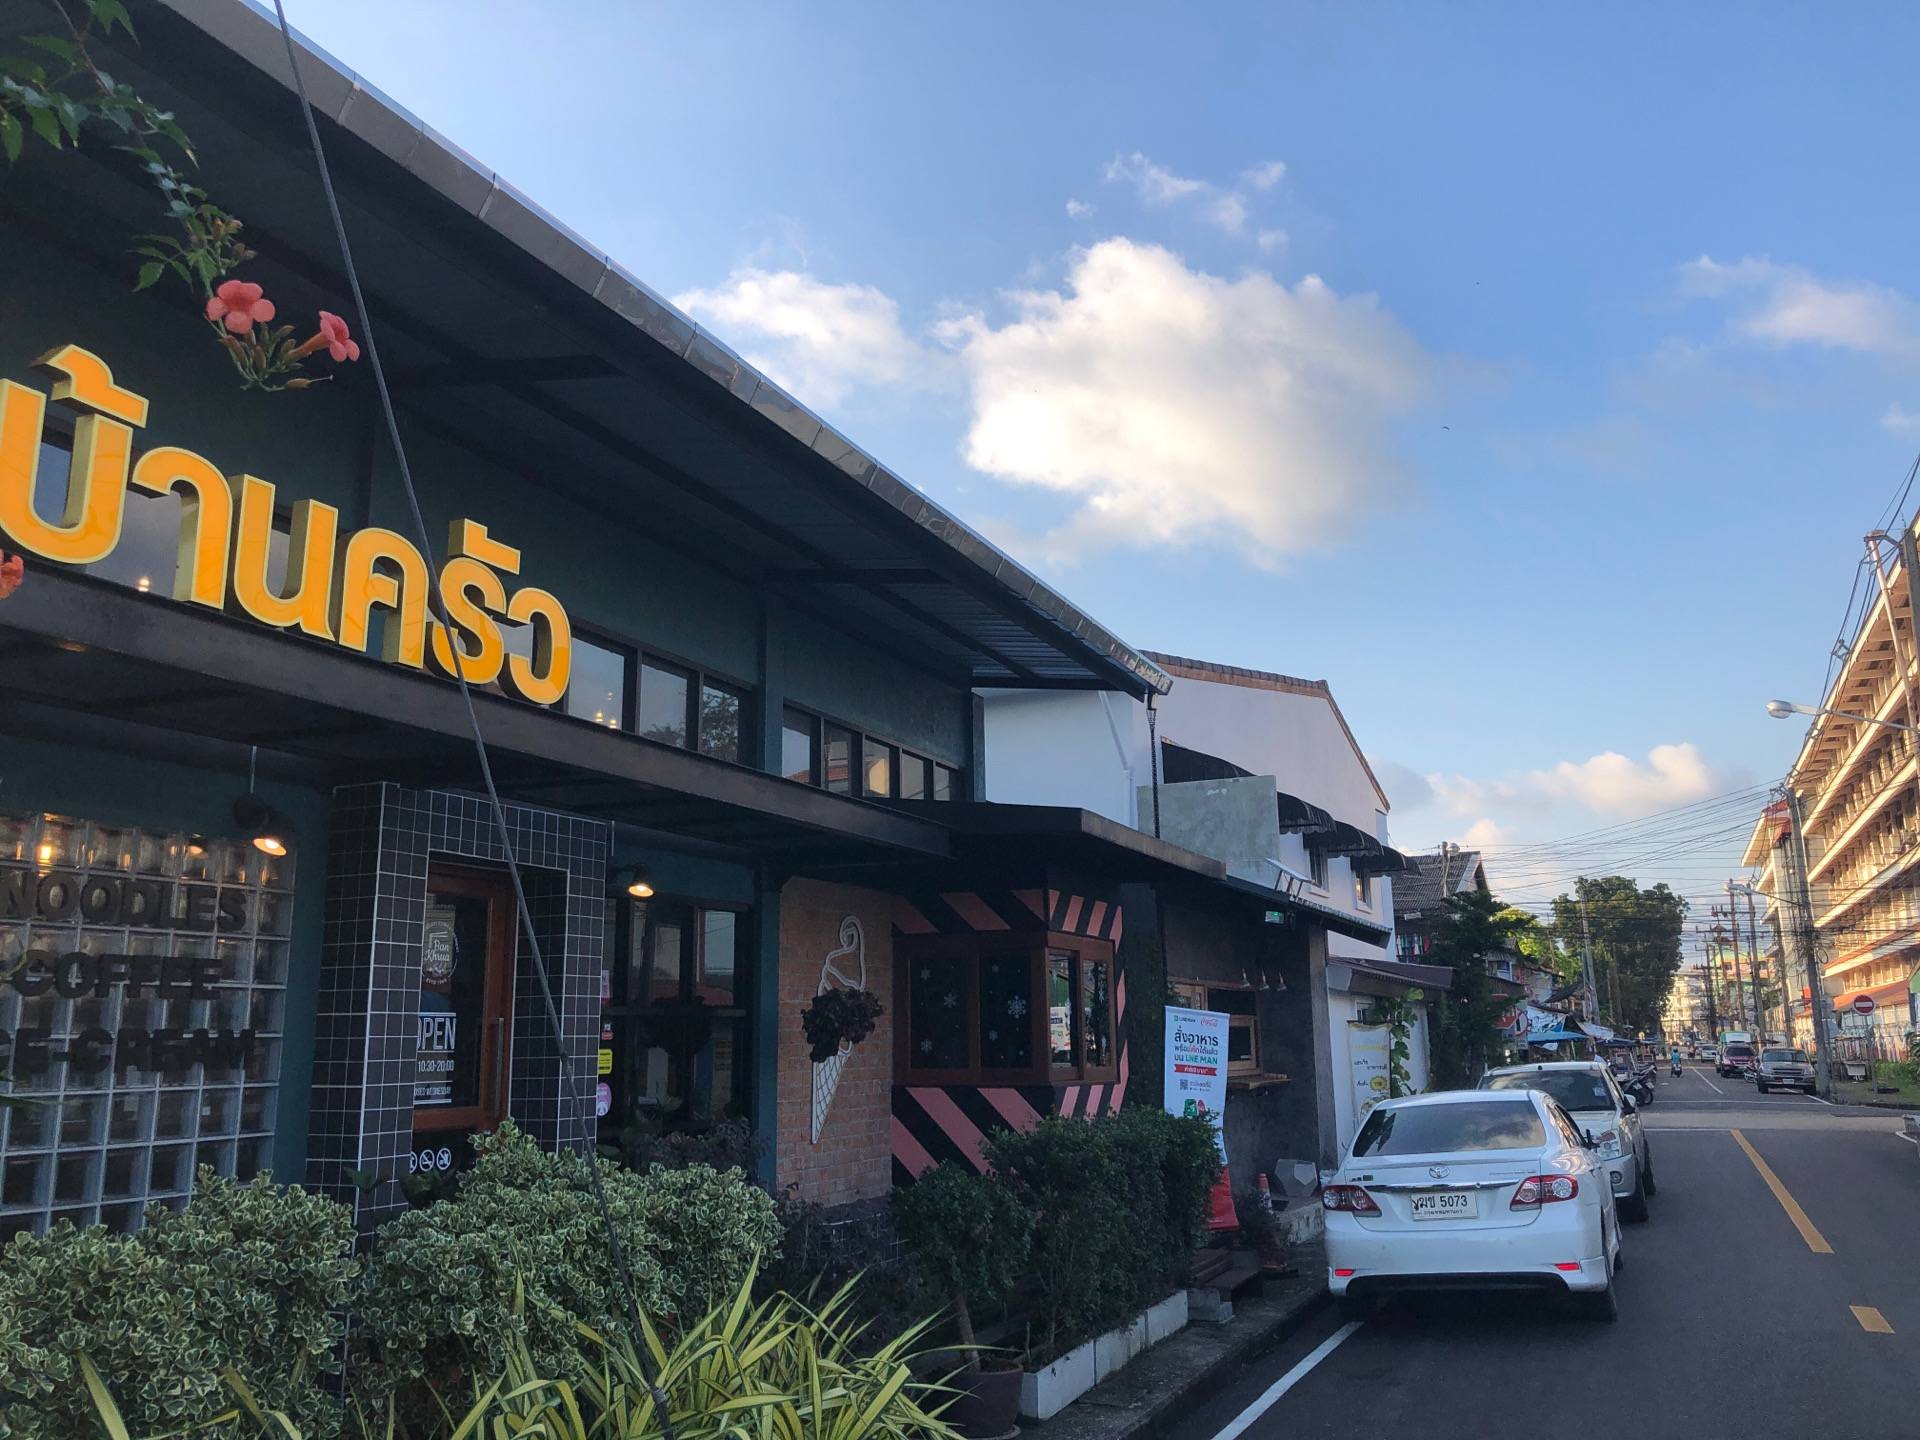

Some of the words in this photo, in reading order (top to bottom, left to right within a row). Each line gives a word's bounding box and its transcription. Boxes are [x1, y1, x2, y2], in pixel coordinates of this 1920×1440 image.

[0, 344, 571, 705] บ้านครัว
[0, 869, 248, 931] NOODLES
[433, 939, 449, 952] Ban
[423, 948, 450, 962] Khrua
[12, 949, 224, 1000] COFFEE
[1174, 1025, 1218, 1047] สั่งอาหาร
[1200, 1056, 1218, 1065] MAN
[1440, 1195, 1468, 1208] 5073
